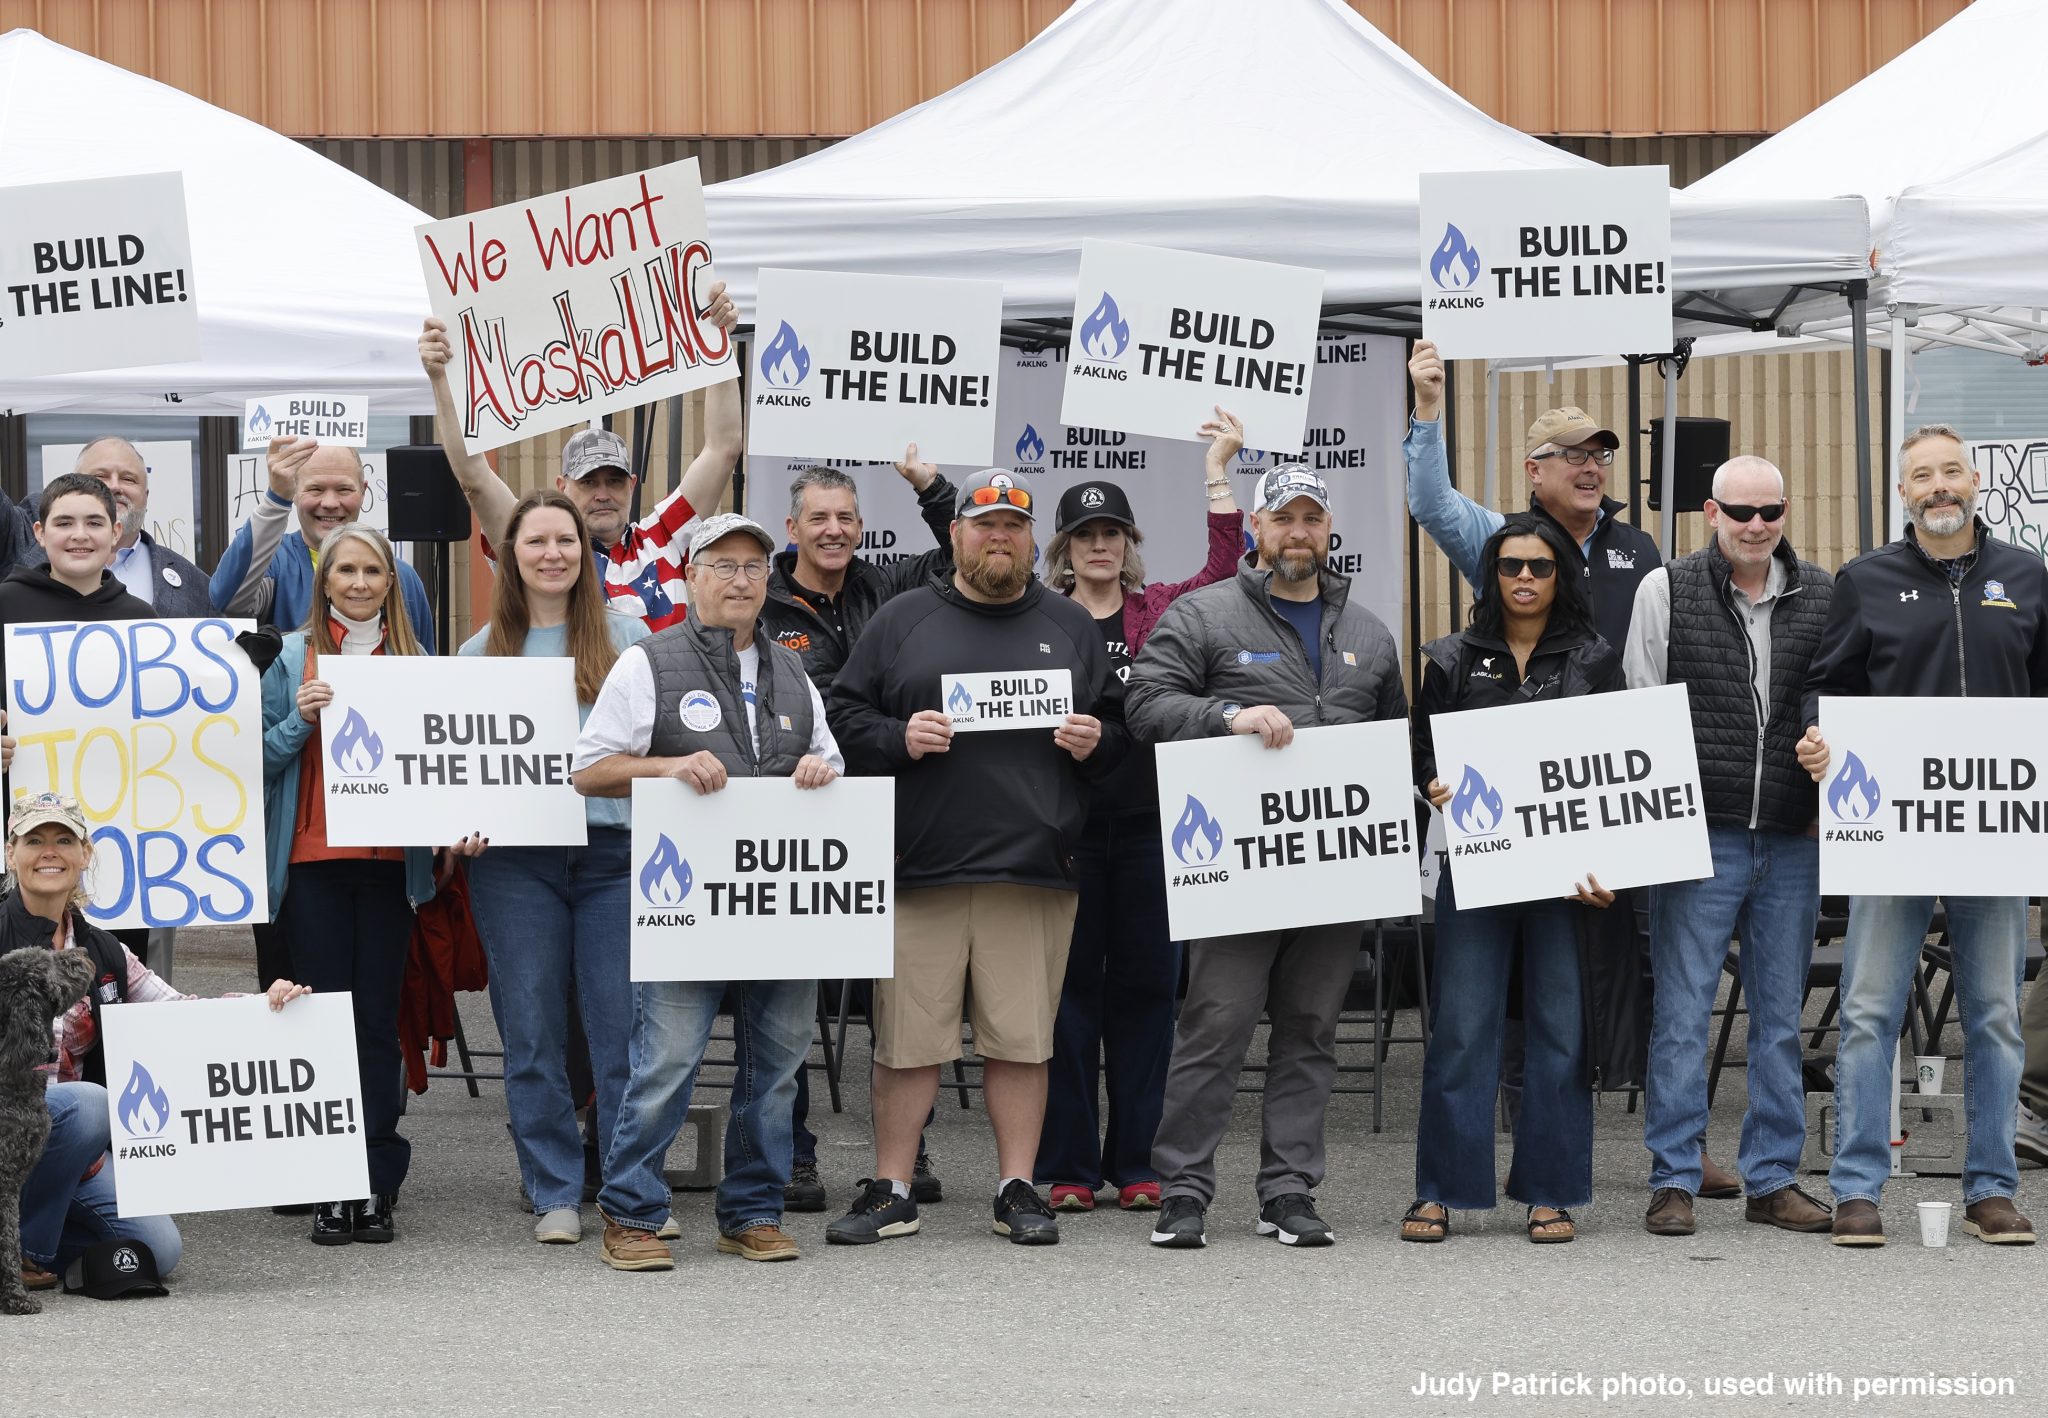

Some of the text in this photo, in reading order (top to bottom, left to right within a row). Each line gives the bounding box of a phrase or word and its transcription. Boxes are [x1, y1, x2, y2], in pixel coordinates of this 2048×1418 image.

[424, 174, 664, 296] We Want
[1519, 224, 1628, 257] BUILD
[33, 234, 145, 274] BUILD
[7, 268, 188, 317] THE LINE!
[1491, 261, 1666, 298] THE LINE!
[1429, 297, 1484, 309] #AKLNG
[458, 239, 733, 438] AlaskaLNG
[1169, 307, 1276, 350] BUILD
[850, 330, 957, 365] BUILD
[1016, 360, 1048, 368] #AKLNG
[1317, 342, 1367, 364] LINE!
[1073, 364, 1128, 381] #AKLNG
[1138, 343, 1306, 396] THE LINE!
[756, 394, 811, 407] #AKLNG
[820, 368, 990, 408] THE LINE!
[289, 400, 346, 418] BUILD
[275, 419, 364, 438] THE LINE!
[1066, 427, 1126, 446] BUILD
[1303, 428, 1346, 447] UILD
[1013, 466, 1046, 474] #AKLNG
[1050, 450, 1146, 470] THE LINE!
[1236, 467, 1267, 475] #AKLNG
[1315, 448, 1366, 470] LINE!
[1977, 486, 2025, 526] OR
[1326, 554, 1362, 574] NE!
[13, 619, 239, 719] JOBS
[990, 678, 1048, 697] BUILD
[976, 697, 1069, 718] THE LINE!
[423, 714, 535, 745] BUILD
[14, 714, 248, 836] JOBS
[395, 752, 574, 786] THE LINE!
[1539, 749, 1652, 793] BUILD
[1923, 757, 2037, 791] BUILD
[330, 783, 389, 795] #AKLNG
[1260, 783, 1370, 825] BUILD
[1514, 783, 1697, 838] THE LINE!
[1892, 800, 2048, 833] THE LIN
[1233, 832, 1306, 870] THE
[1316, 819, 1411, 862] LINE!
[1454, 838, 1512, 857] #AKLNG
[1825, 830, 1884, 842] #AKLNG
[735, 838, 849, 873] BUILD
[80, 825, 254, 928] OBS
[1172, 870, 1229, 887] #AKLNG
[703, 880, 886, 916] THE LINE!
[637, 914, 696, 927] #AKLNG
[206, 1058, 315, 1098] BUILD
[181, 1098, 357, 1145] THE LINE!
[119, 1143, 176, 1160] #AKLNG
